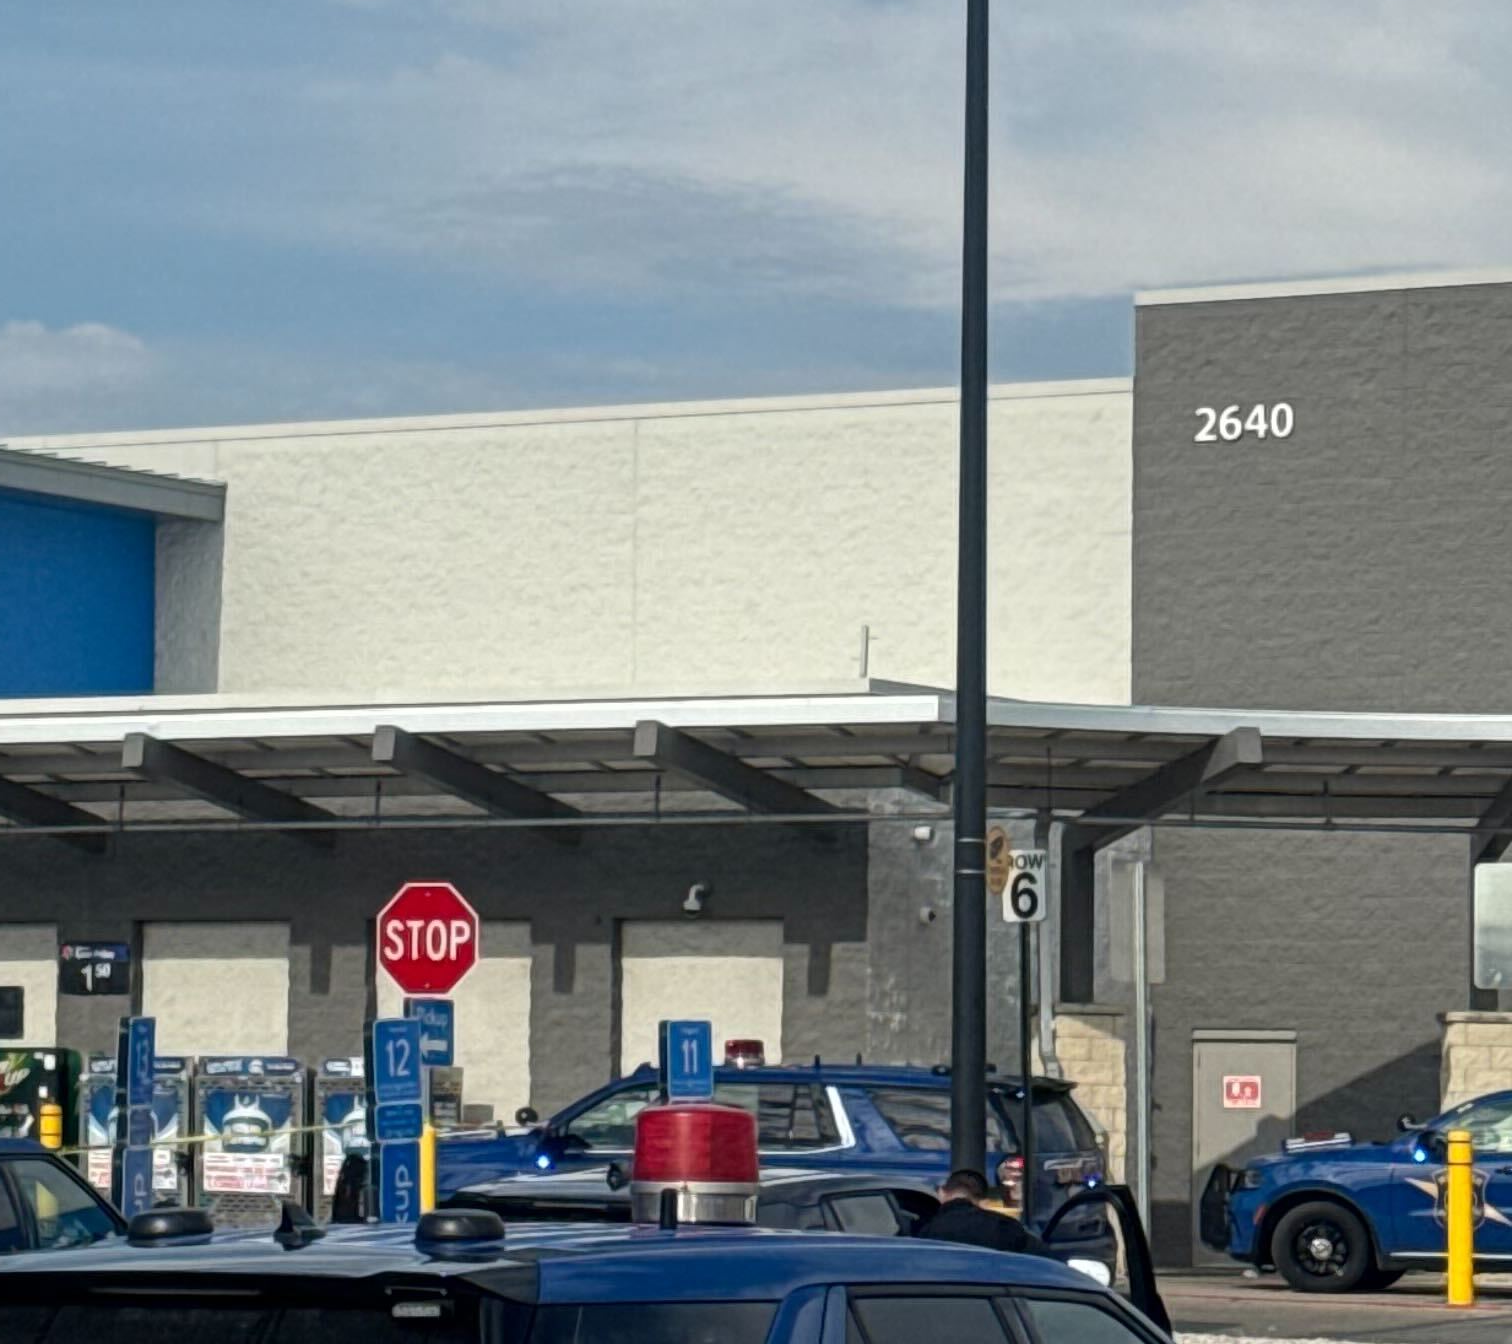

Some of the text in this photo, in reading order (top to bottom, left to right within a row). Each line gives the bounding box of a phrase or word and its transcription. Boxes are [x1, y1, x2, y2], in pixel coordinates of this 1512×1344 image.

[1193, 402, 1295, 443] 2640
[1010, 871, 1039, 919] 6
[383, 918, 471, 962] STOP
[385, 1037, 411, 1078] 12
[681, 1039, 698, 1074] 11
